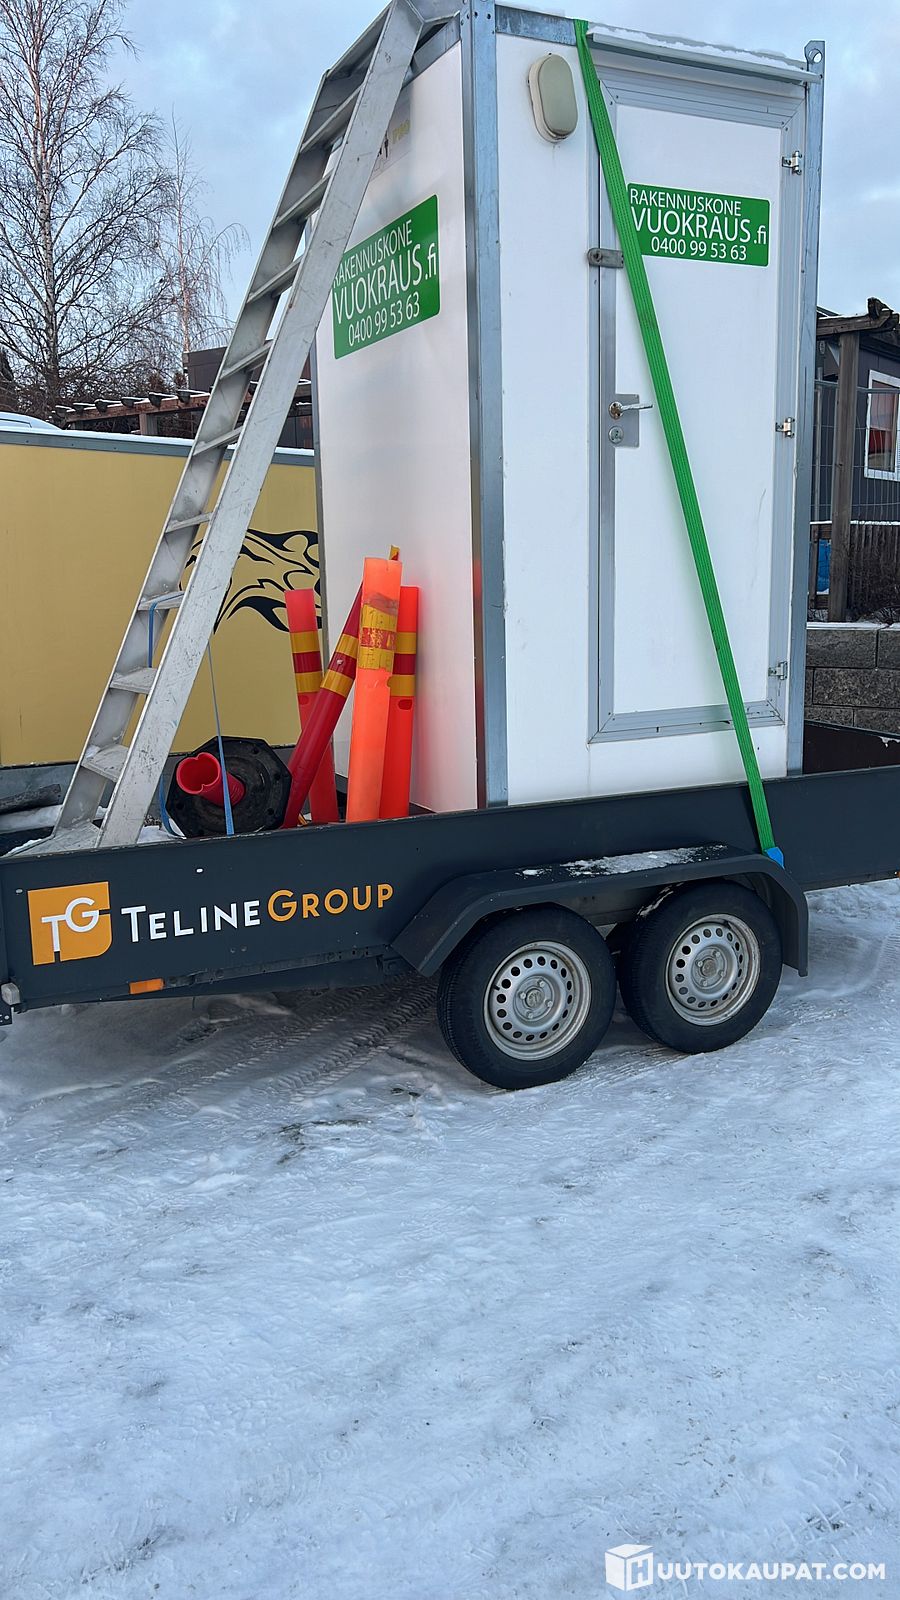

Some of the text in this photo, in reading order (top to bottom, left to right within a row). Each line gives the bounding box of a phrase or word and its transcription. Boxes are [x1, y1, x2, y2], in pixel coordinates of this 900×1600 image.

[630, 188, 742, 217] RAKENNUSKONE
[651, 236, 747, 261] 0400 99 53 63
[348, 291, 420, 347] 0400 99 53 63
[41, 897, 100, 953] TG
